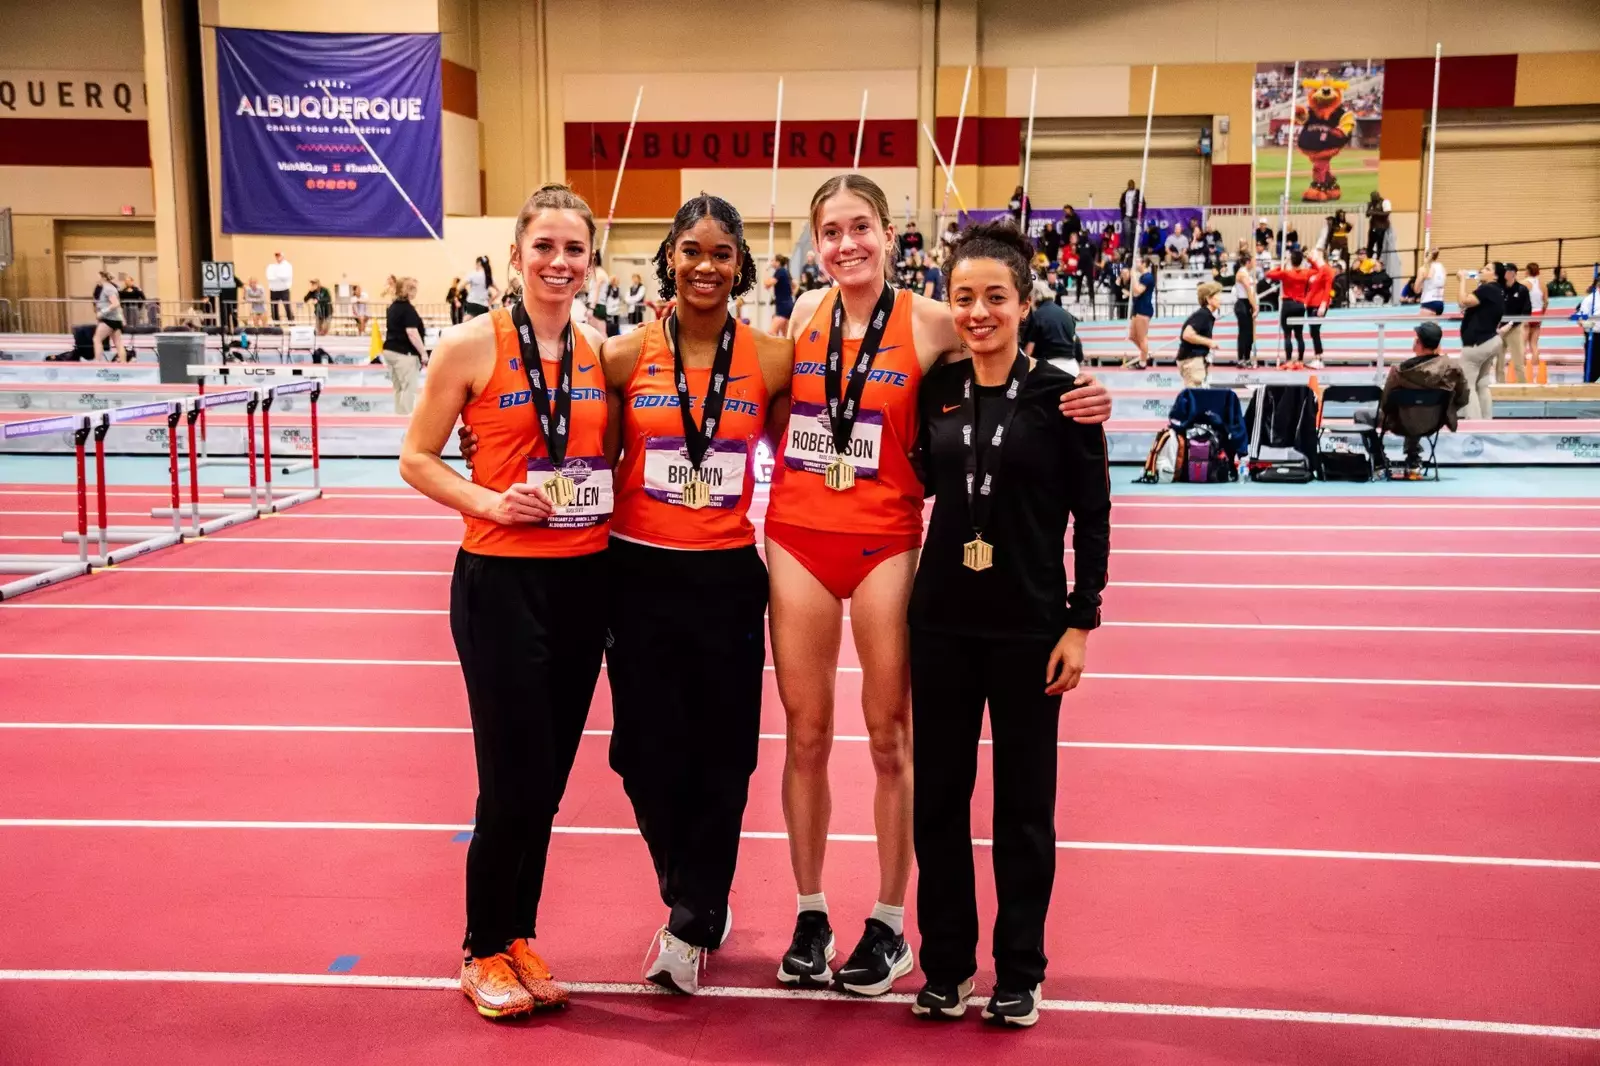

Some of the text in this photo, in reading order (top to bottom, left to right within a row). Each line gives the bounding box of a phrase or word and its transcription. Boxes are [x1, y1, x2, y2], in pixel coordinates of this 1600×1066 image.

[0, 81, 148, 113] QUERQ
[266, 124, 302, 133] CHANGE
[305, 125, 330, 133] YOUR
[244, 368, 276, 376] UCS
[791, 430, 874, 459] ROBERSON
